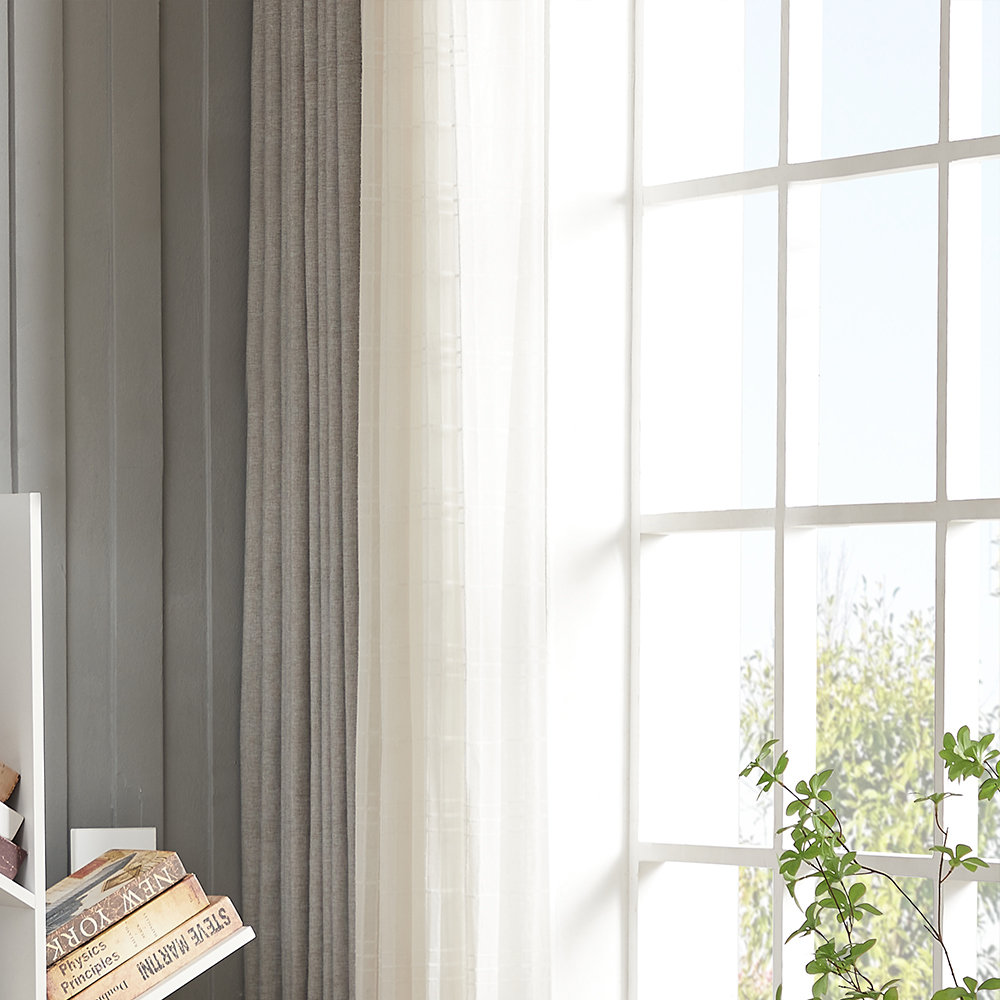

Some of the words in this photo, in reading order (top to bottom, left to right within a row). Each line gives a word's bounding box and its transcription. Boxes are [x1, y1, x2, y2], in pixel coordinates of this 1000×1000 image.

[121, 868, 178, 913] NEW
[46, 909, 113, 961] YORK
[189, 907, 232, 947] STEVE
[58, 940, 107, 976] Physics
[60, 951, 121, 995] Principles
[136, 934, 190, 981] MARTINI
